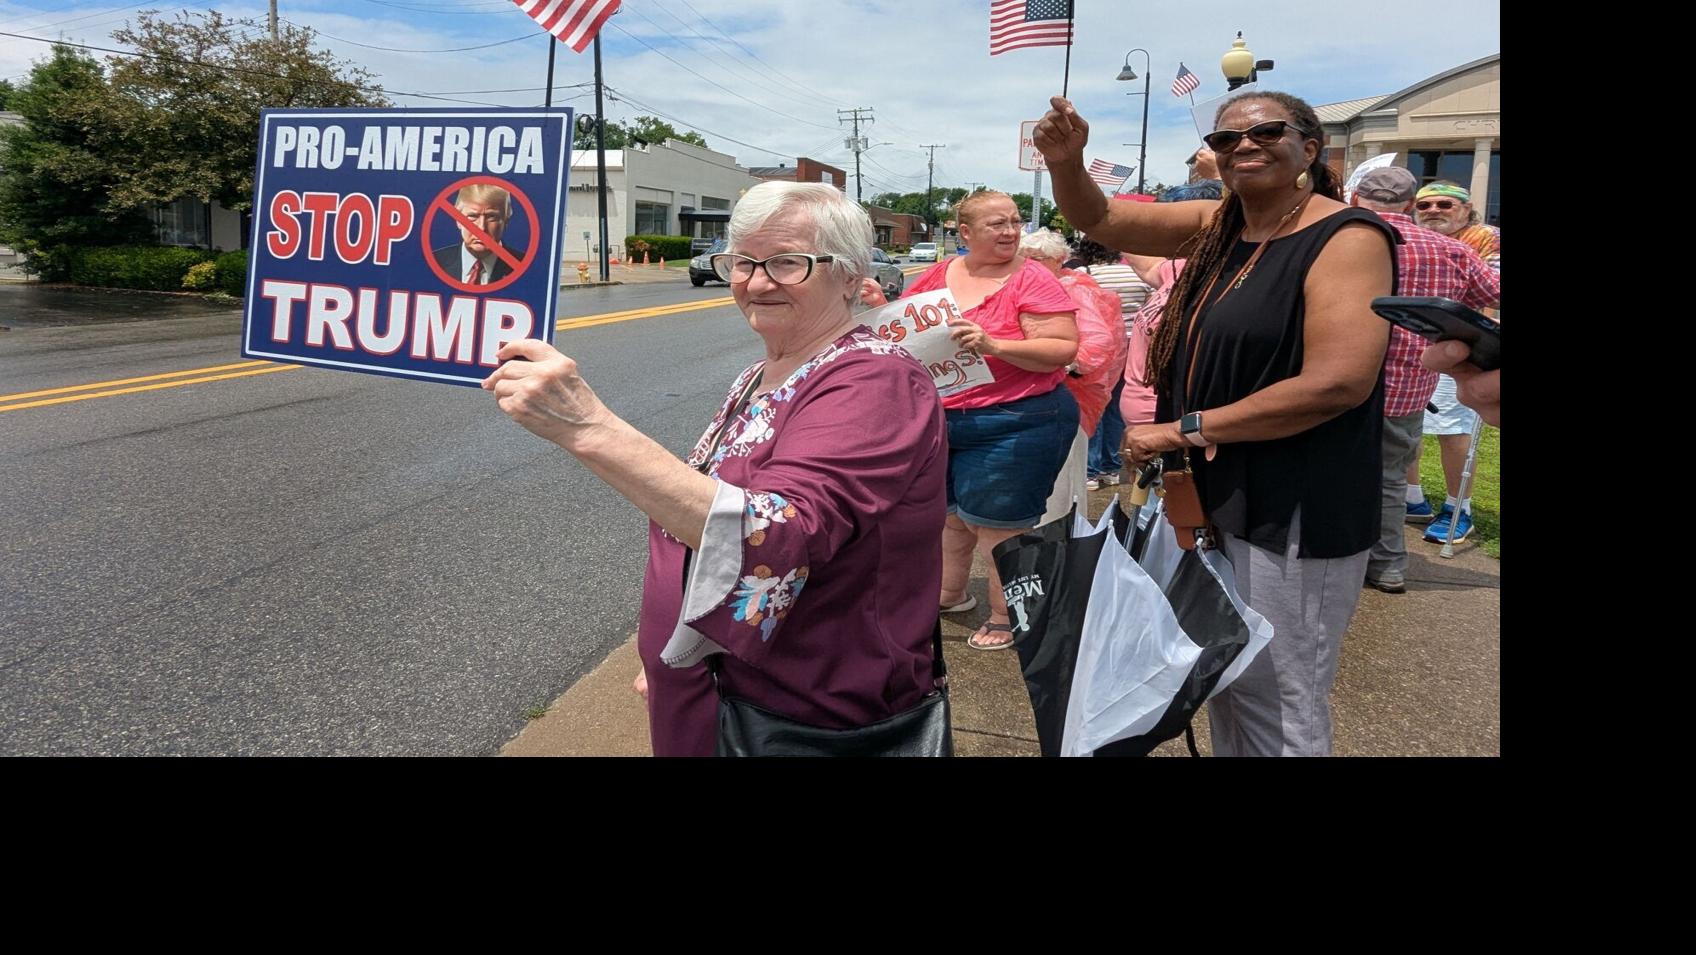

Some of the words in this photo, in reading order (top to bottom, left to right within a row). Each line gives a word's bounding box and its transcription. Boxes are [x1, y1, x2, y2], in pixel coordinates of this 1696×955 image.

[273, 125, 545, 174] PRO-AMERICA
[266, 189, 415, 266] STOP
[262, 279, 534, 367] TRUMP
[879, 319, 907, 342] cs
[1004, 580, 1045, 600] Men
